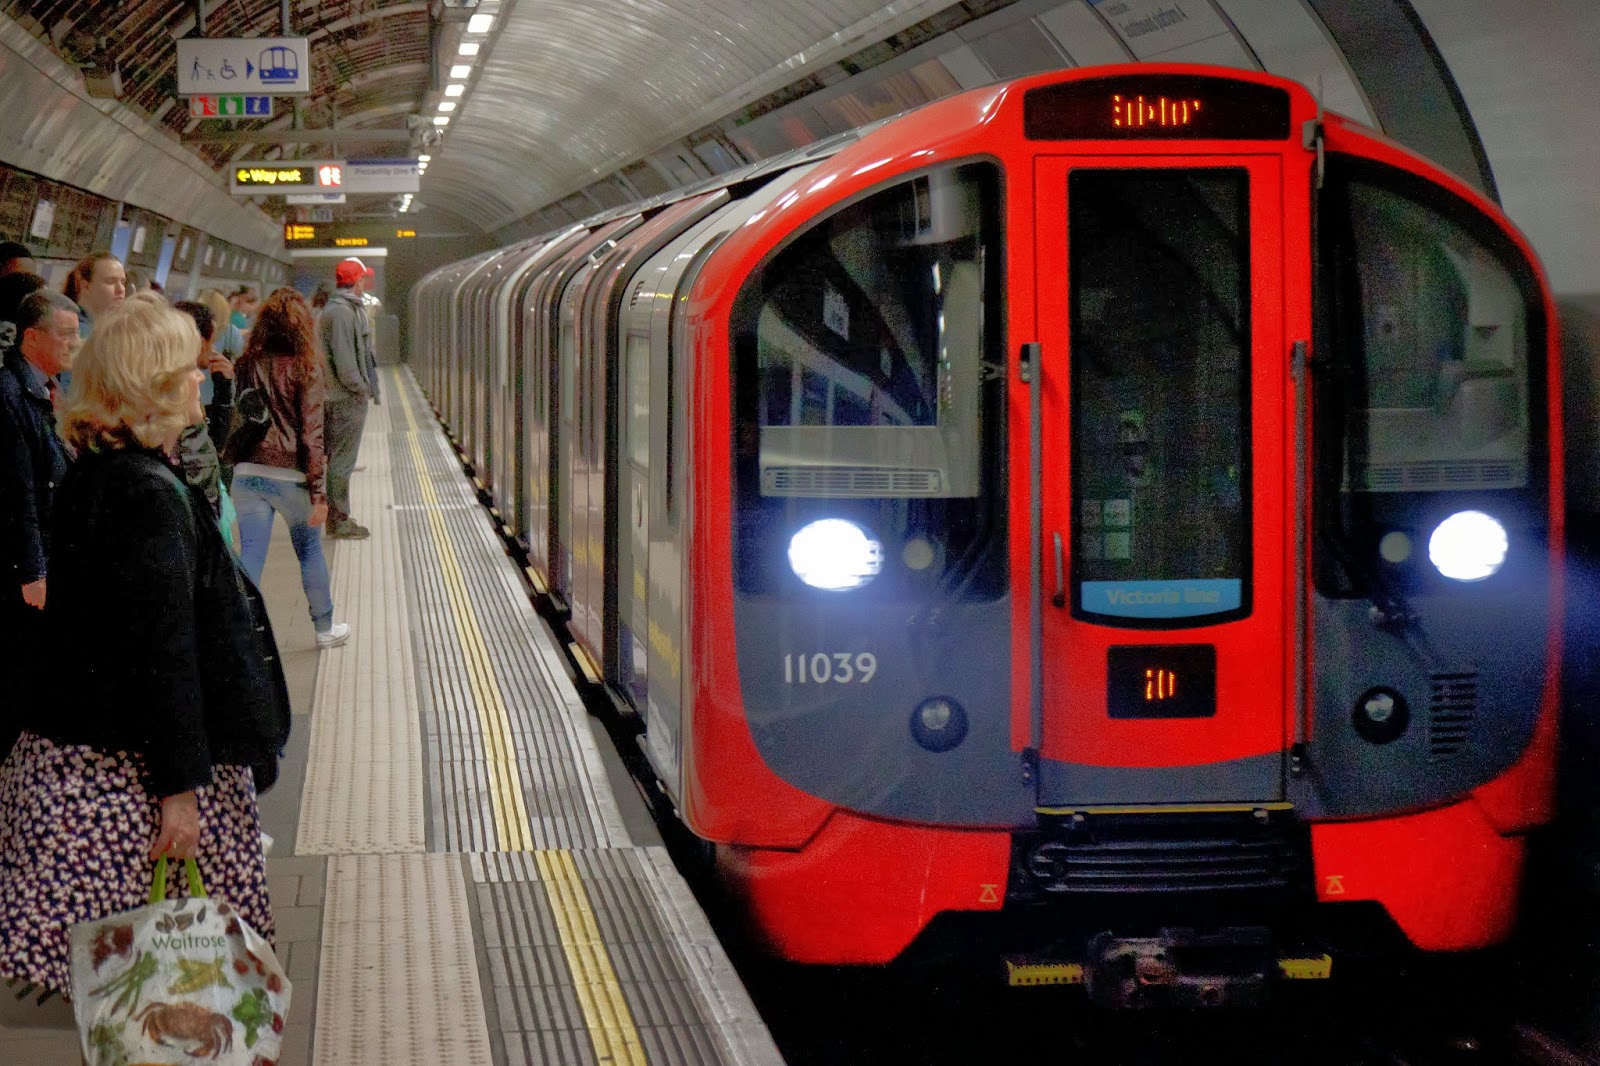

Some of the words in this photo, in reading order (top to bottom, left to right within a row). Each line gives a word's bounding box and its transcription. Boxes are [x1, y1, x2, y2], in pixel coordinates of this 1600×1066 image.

[249, 169, 277, 184] Way
[278, 169, 301, 182] out
[1107, 588, 1180, 604] Victoria
[1184, 587, 1220, 603] line
[784, 652, 877, 684] 11039
[151, 933, 226, 951] Waitrose
